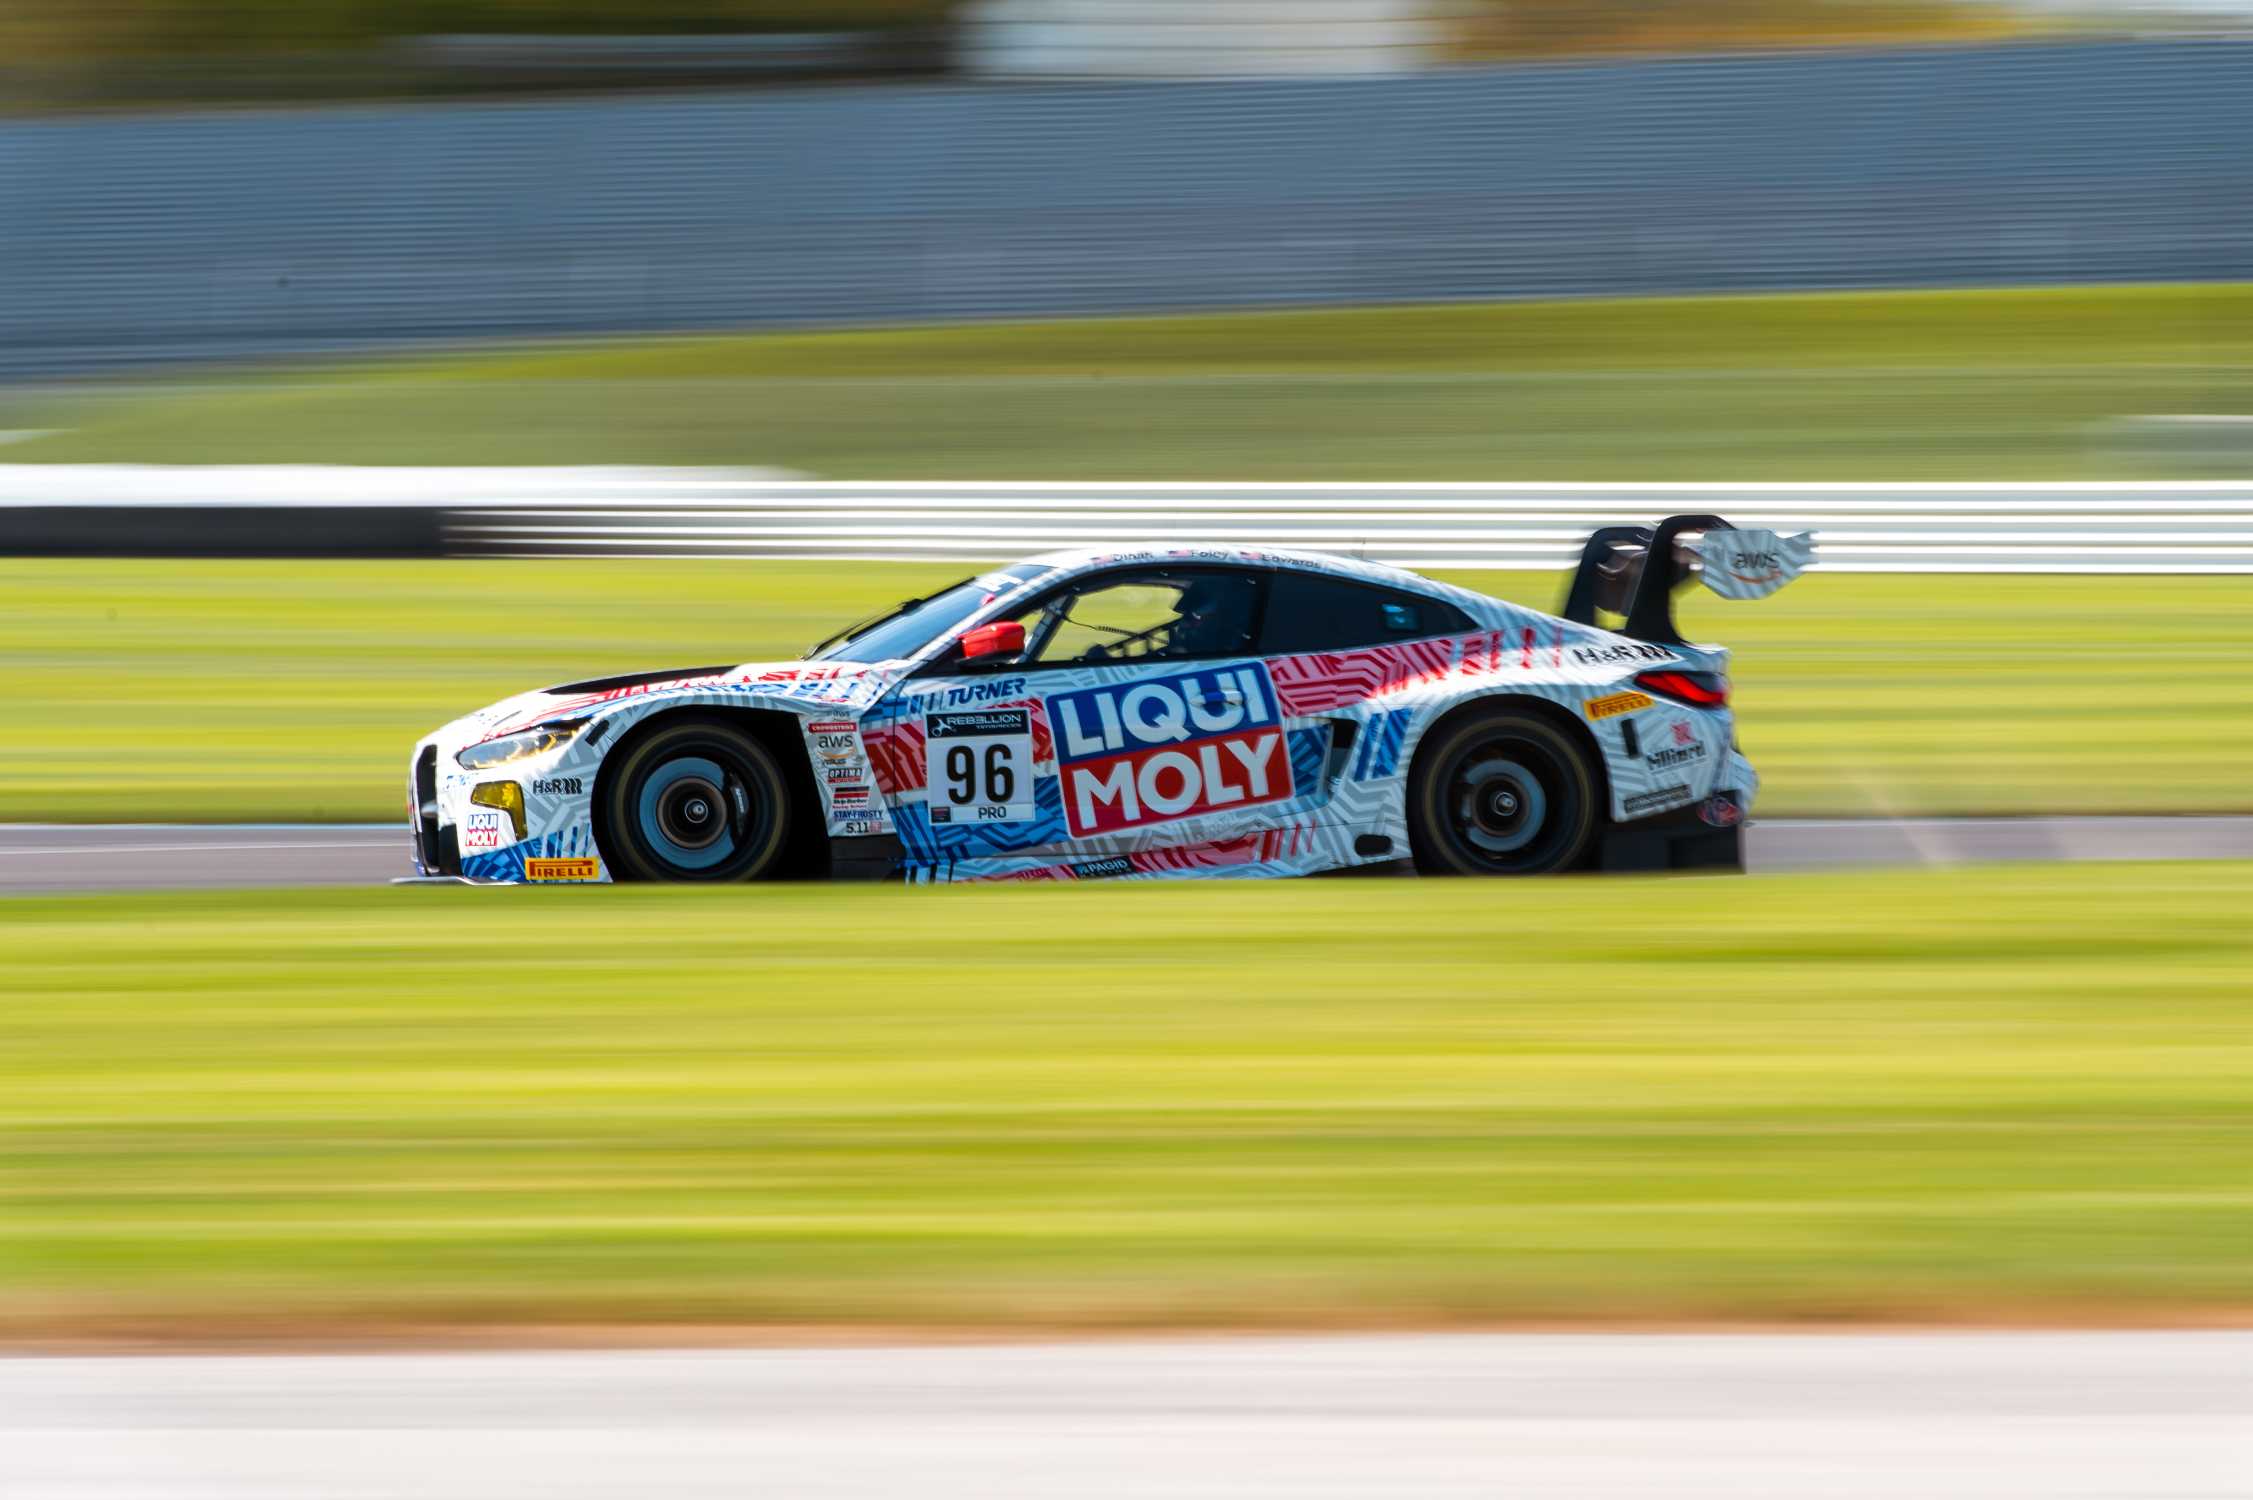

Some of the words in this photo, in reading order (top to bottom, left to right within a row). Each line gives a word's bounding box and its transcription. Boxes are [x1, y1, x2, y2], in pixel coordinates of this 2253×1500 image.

[948, 677, 1026, 707] TURNER
[1057, 668, 1270, 758] LIQUI
[818, 735, 854, 749] aws
[829, 768, 862, 778] OPTIMA
[946, 743, 1014, 806] 96
[1071, 733, 1280, 830] MOLY
[532, 778, 562, 795] H&R
[467, 813, 499, 830] LIQUI
[978, 806, 1007, 820] PRO
[846, 822, 869, 834] 5.11
[465, 830, 498, 847] MOLY
[529, 860, 594, 877] PIRELLI
[1088, 859, 1129, 873] PAGID
